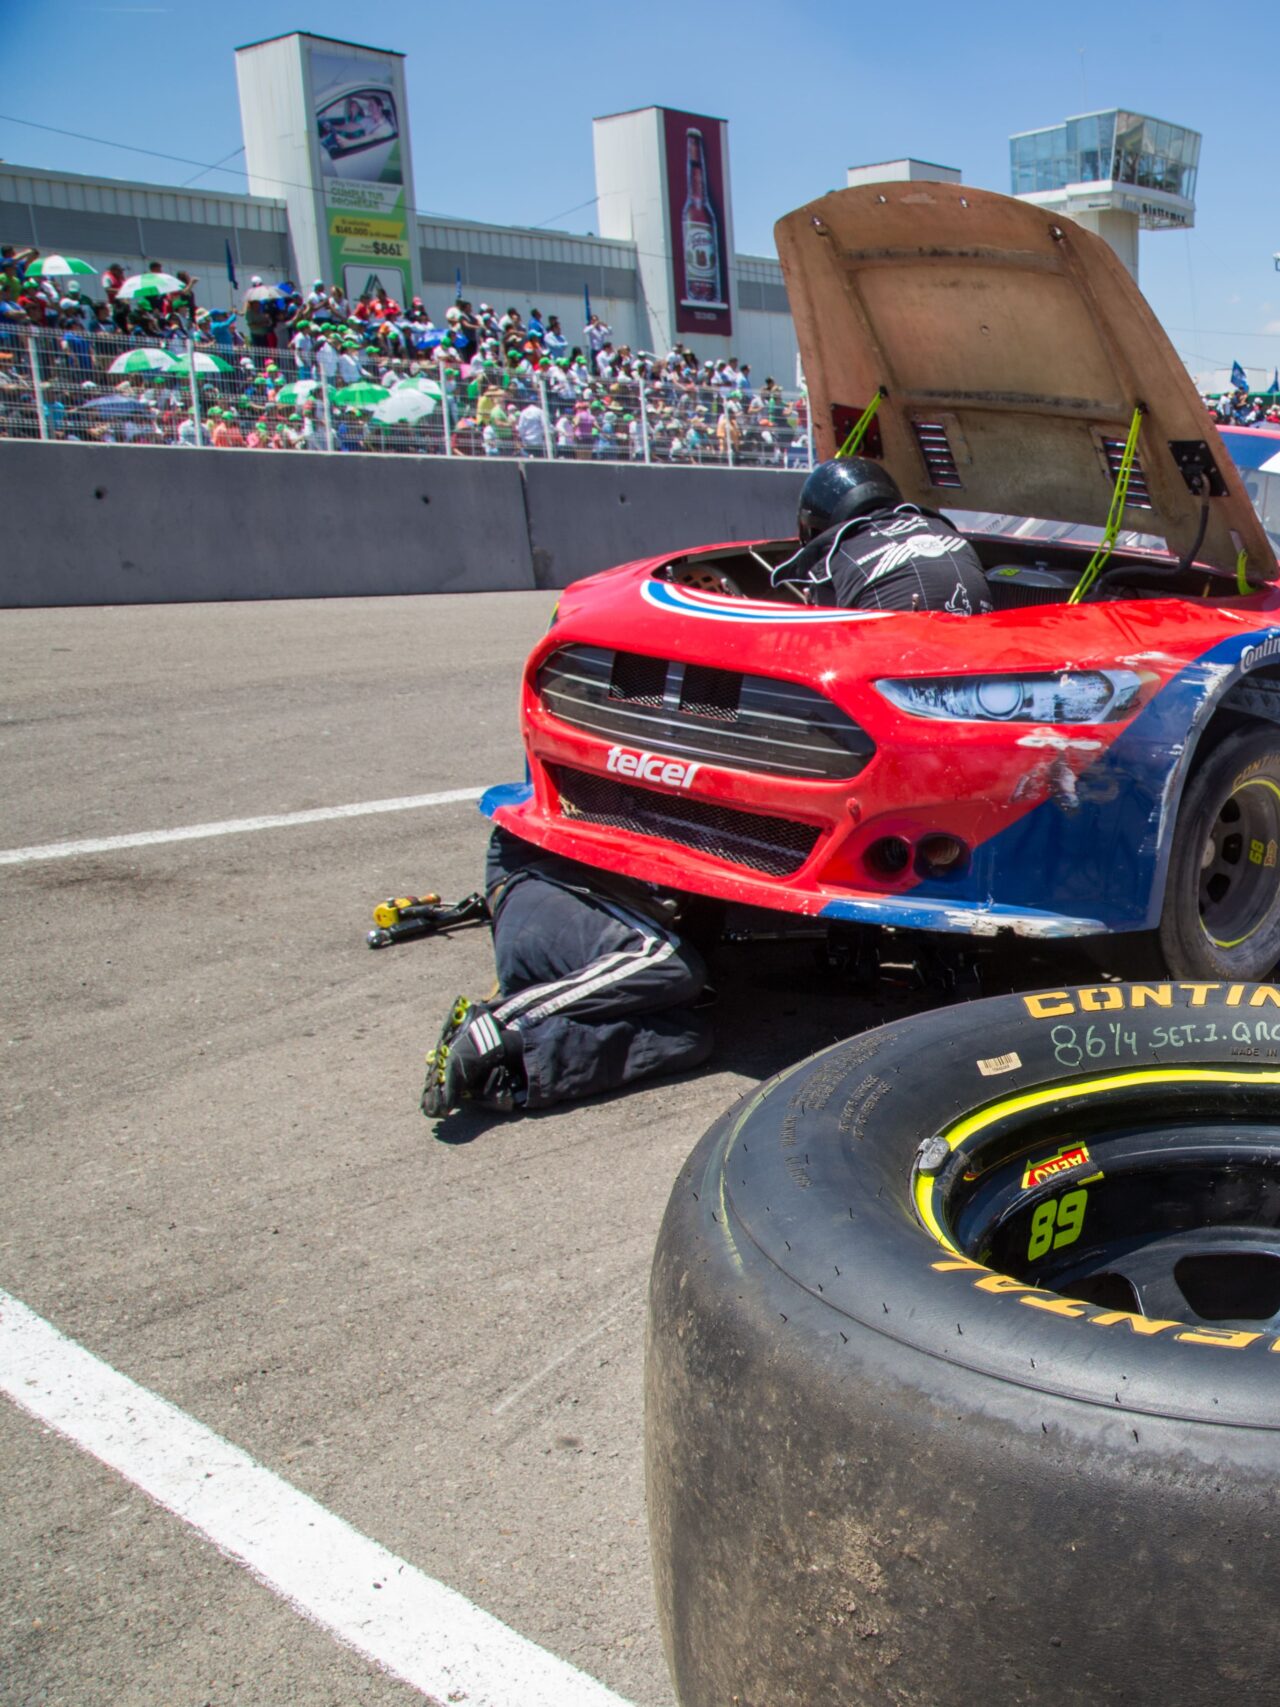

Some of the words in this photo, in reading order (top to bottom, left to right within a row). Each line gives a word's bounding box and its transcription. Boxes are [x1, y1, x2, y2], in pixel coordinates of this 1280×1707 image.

[373, 242, 402, 256] $861
[607, 746, 701, 788] telcel
[1231, 1048, 1260, 1057] MADE
[1266, 1048, 1278, 1058] IN
[1033, 1153, 1084, 1186] AERO
[1027, 1189, 1088, 1261] 68
